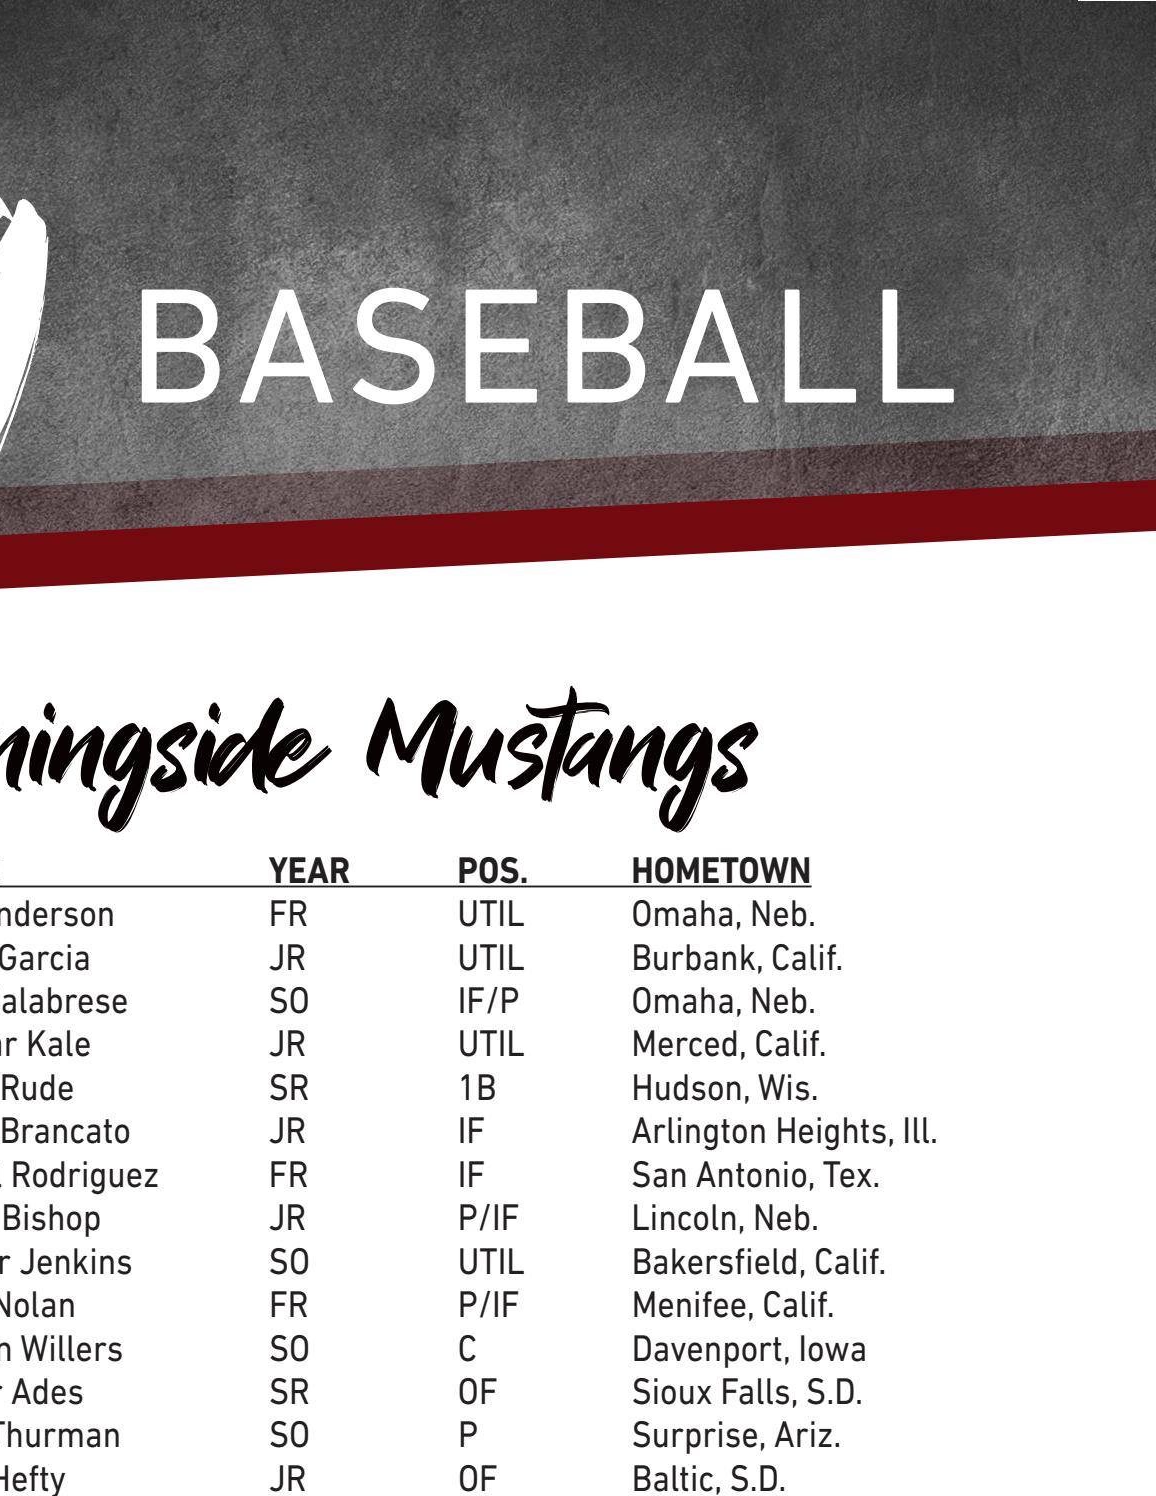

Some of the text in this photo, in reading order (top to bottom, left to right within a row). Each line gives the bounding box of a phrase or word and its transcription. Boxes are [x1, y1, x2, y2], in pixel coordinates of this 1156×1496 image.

[141, 287, 955, 405] BASEBALL
[366, 686, 758, 832] Mustangs
[268, 856, 350, 884] YEAR
[458, 856, 528, 884] POS.
[632, 856, 810, 885] HOMETOWN
[270, 899, 308, 927] FR
[459, 899, 525, 927] UTIL
[632, 899, 741, 931] Omaha,
[752, 899, 815, 927] Neb.
[28, 1029, 91, 1057] Kale
[269, 1029, 306, 1057] JR
[459, 1029, 525, 1057] UTIL
[633, 1029, 746, 1061] Merced,
[755, 1029, 825, 1057] Calif.
[12, 1160, 158, 1195] Rodriguez
[270, 1160, 308, 1188] FR
[459, 1160, 485, 1188] IF
[632, 1160, 686, 1189] San
[695, 1160, 814, 1192] Antonio,
[822, 1160, 879, 1188] Tex.
[19, 1247, 132, 1276] Jenkins
[269, 1247, 309, 1276] SO
[459, 1247, 525, 1276] UTIL
[633, 1247, 805, 1279] Bakersfield,
[815, 1247, 885, 1275] Calif.
[11, 1377, 83, 1405] Ades
[270, 1377, 309, 1405] SR
[459, 1377, 498, 1405] OF
[632, 1377, 712, 1405] Sioux
[722, 1377, 797, 1409] Falls,
[807, 1377, 862, 1405] S.D.
